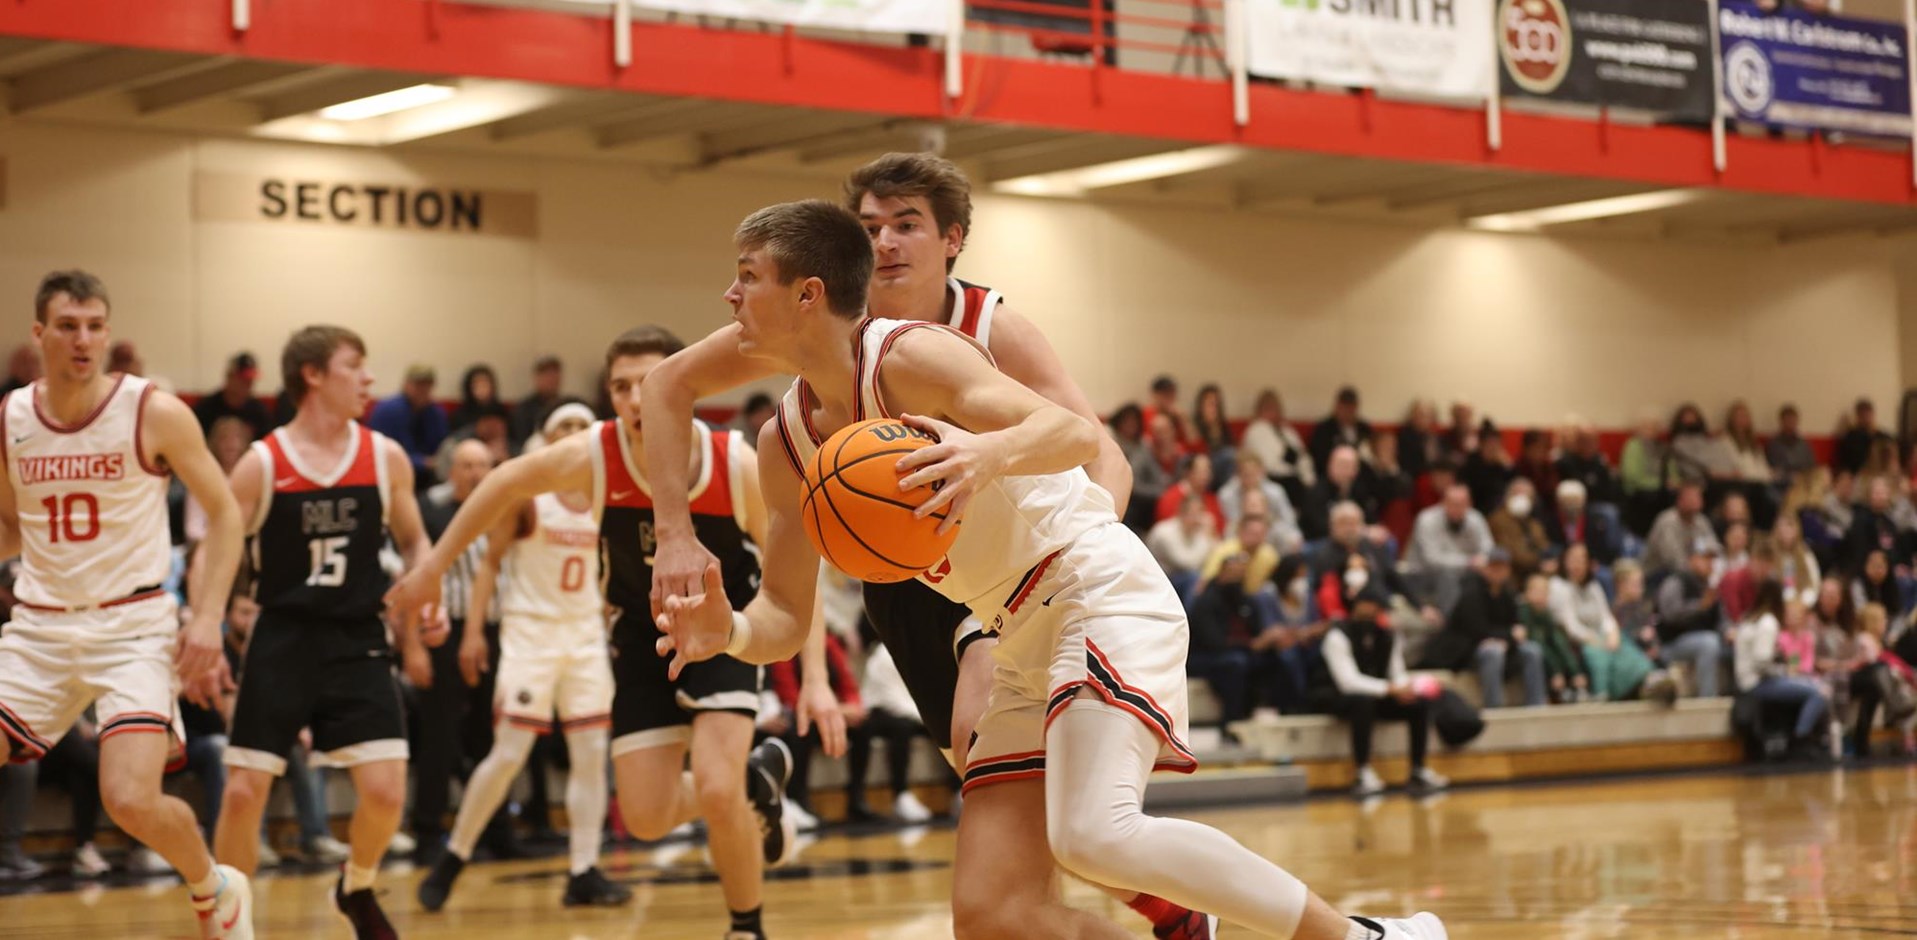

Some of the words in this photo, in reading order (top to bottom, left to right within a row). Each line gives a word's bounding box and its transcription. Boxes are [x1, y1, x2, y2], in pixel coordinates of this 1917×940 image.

[260, 179, 483, 231] SECTION
[18, 453, 125, 486] VIKINGS
[41, 492, 100, 543] 10
[302, 497, 358, 534] MLC
[306, 536, 350, 587] 15
[560, 556, 586, 592] 0
